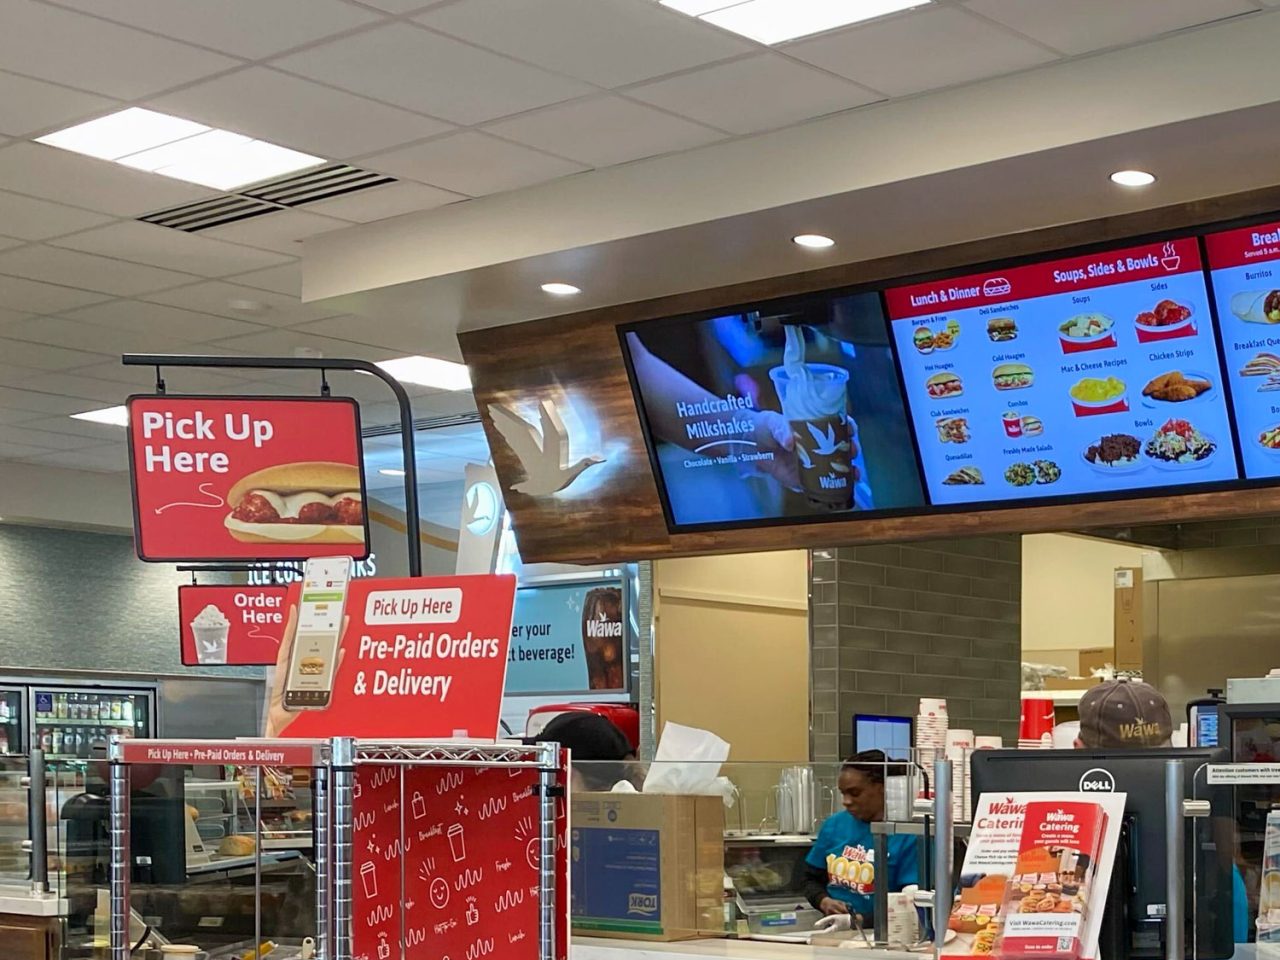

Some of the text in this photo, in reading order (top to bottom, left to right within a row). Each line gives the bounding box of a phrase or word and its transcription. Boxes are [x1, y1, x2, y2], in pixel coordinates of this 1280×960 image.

[1054, 254, 1158, 283] Soups, Sides & Bowls
[1245, 268, 1273, 280] Burritos
[1150, 282, 1168, 291] Sides
[911, 285, 980, 307] Lunch & Dinner
[1072, 295, 1090, 305] Soups
[1234, 338, 1265, 350] Breakfast
[1149, 349, 1194, 362] Chicken Strips
[1061, 358, 1127, 373] Mac Cheese Recipes
[676, 392, 753, 418] Handcrafted
[142, 412, 273, 447] Pick Up
[686, 416, 754, 440] Milkshakes
[145, 446, 229, 473] Here
[742, 451, 774, 464] Strawberry
[234, 593, 282, 607] Order
[373, 598, 452, 617] Pick Up Here
[243, 610, 283, 624] Here
[527, 623, 550, 638] your
[586, 619, 622, 637] Wawa
[359, 635, 432, 660] Pre-Paid
[436, 632, 499, 657] Orders
[519, 646, 575, 662] beverage!
[354, 670, 451, 702] & Delivery
[1120, 721, 1161, 739] Wawa
[148, 749, 284, 763] Pick Up Here Pre-Paid Orders & Delivery
[1084, 781, 1110, 790] DELL
[1039, 823, 1079, 833] Catering
